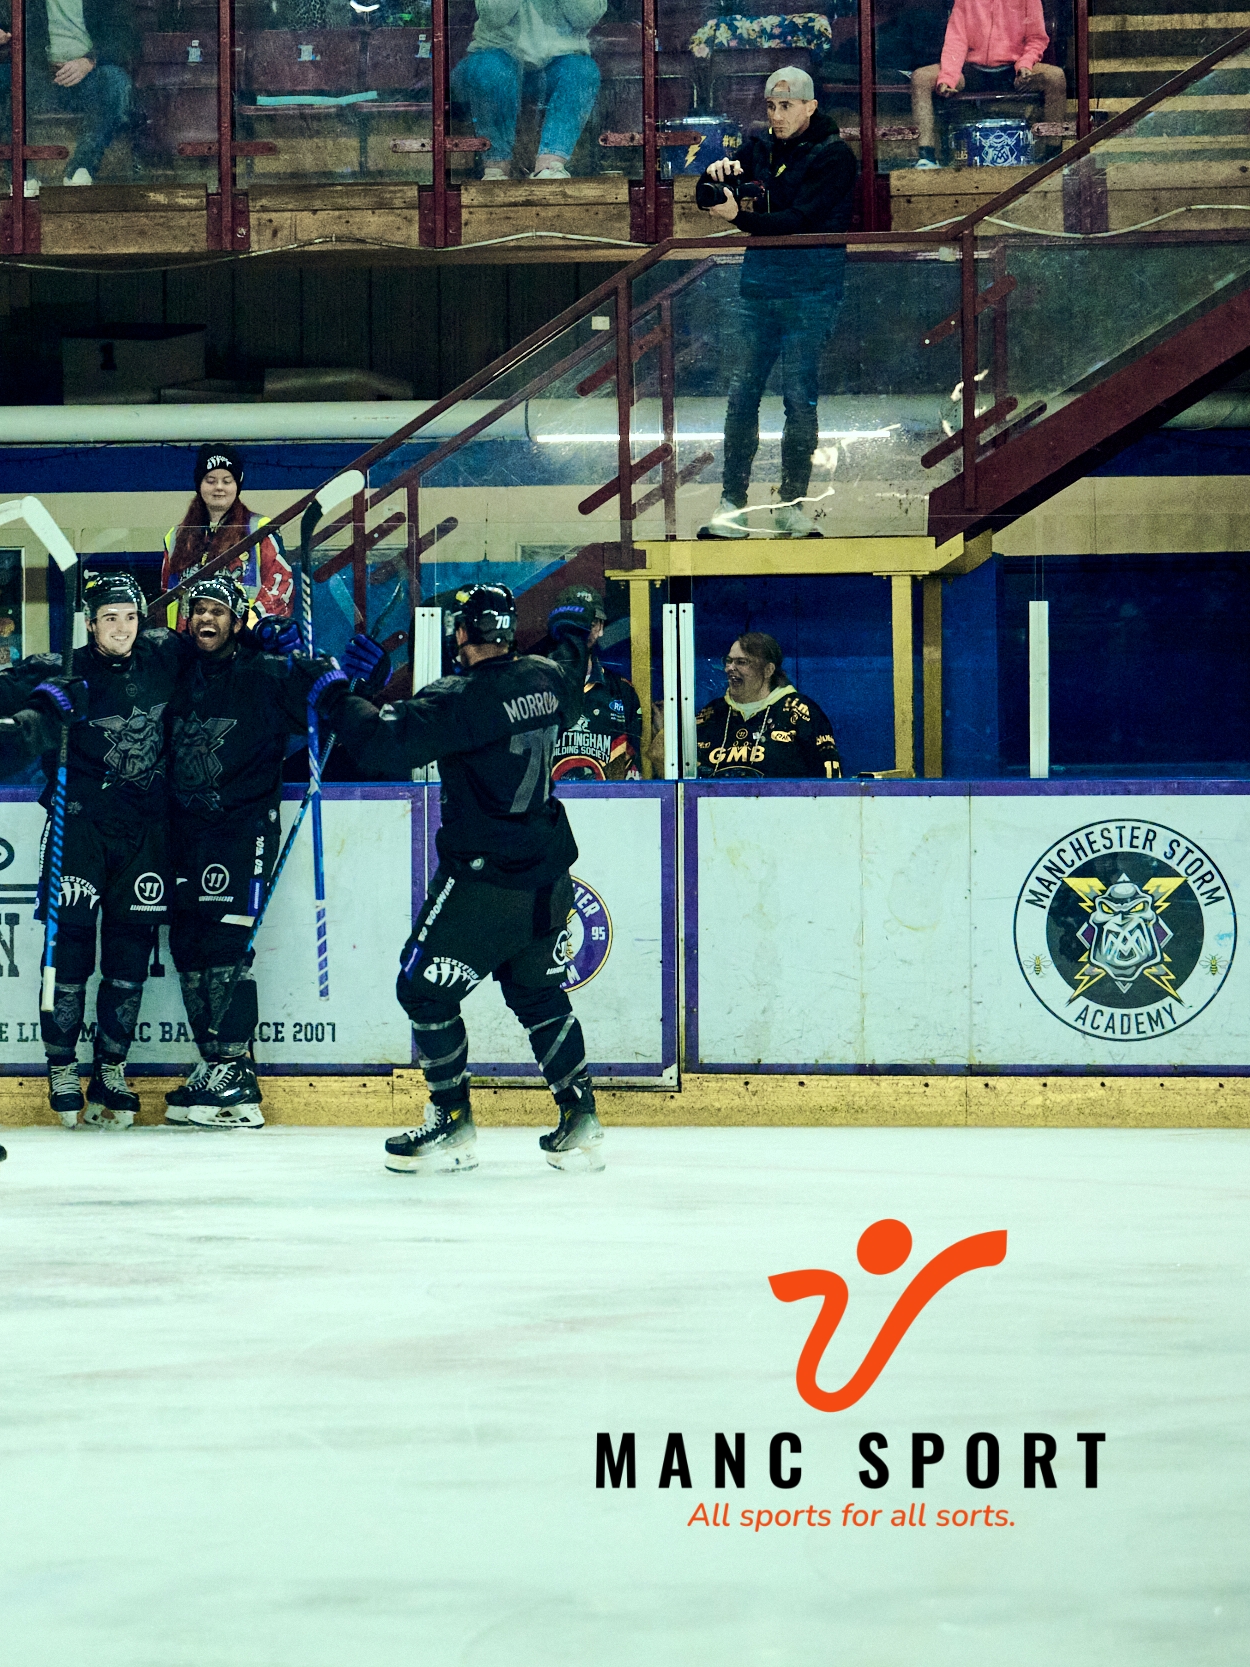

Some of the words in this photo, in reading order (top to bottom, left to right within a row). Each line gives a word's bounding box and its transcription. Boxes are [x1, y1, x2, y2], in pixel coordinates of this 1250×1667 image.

[495, 615, 511, 630] 70
[708, 745, 766, 764] GMB
[1025, 825, 1158, 910] MANCHESTER
[1163, 838, 1225, 908] STORM
[591, 926, 606, 941] 95
[432, 956, 480, 980] DIZZYFISH
[1073, 1002, 1178, 1036] ACADEMY
[292, 1021, 337, 1043] 2007
